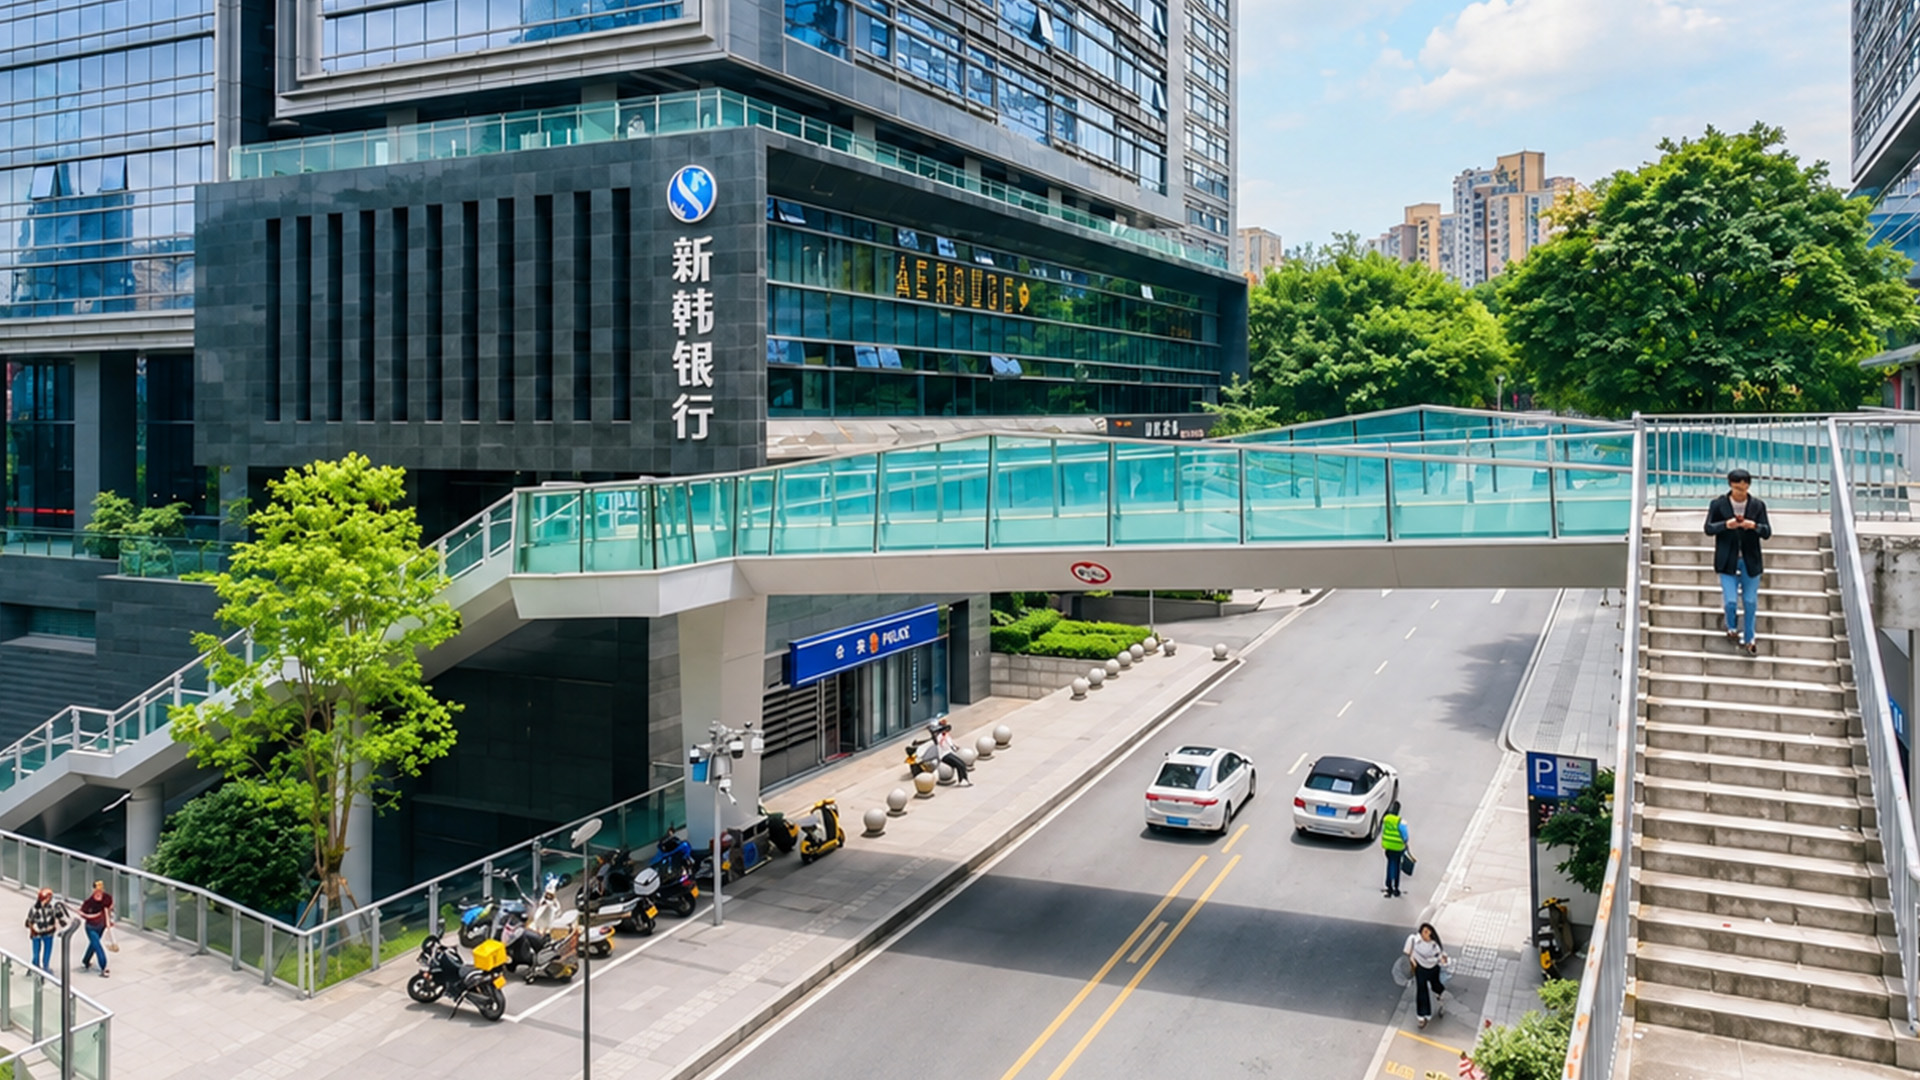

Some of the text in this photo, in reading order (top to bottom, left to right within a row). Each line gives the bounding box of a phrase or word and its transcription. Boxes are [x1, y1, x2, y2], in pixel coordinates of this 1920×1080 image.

[671, 234, 715, 441] 新韩银行
[1535, 758, 1554, 784] P
